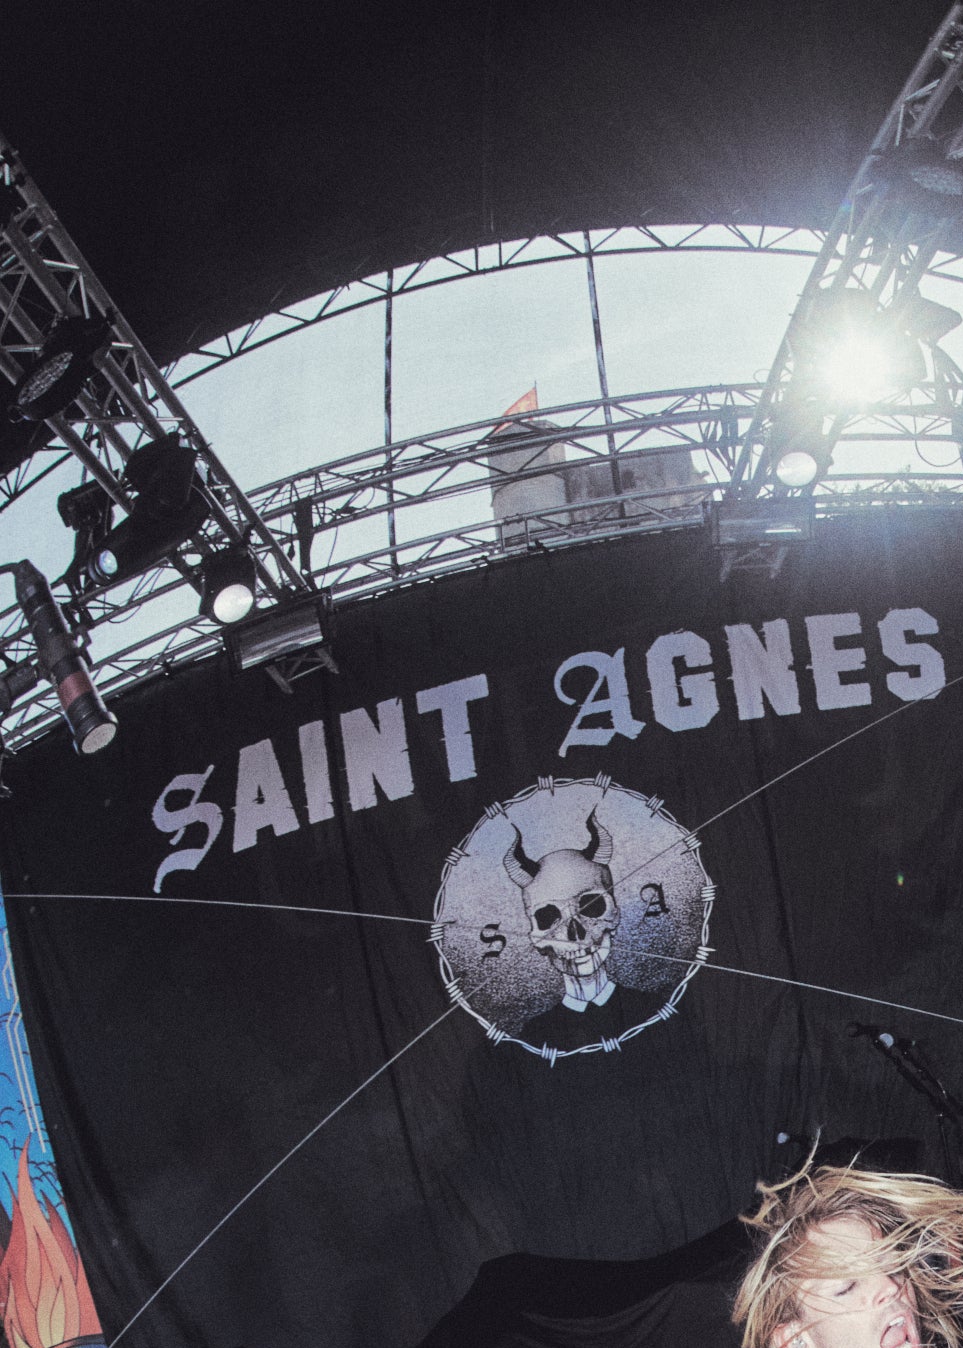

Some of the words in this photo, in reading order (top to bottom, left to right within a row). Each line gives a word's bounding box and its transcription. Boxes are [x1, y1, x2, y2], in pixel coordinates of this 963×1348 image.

[152, 674, 490, 893] SAINT
[553, 607, 945, 758] AGNES
[480, 922, 507, 964] S
[640, 883, 670, 925] A
